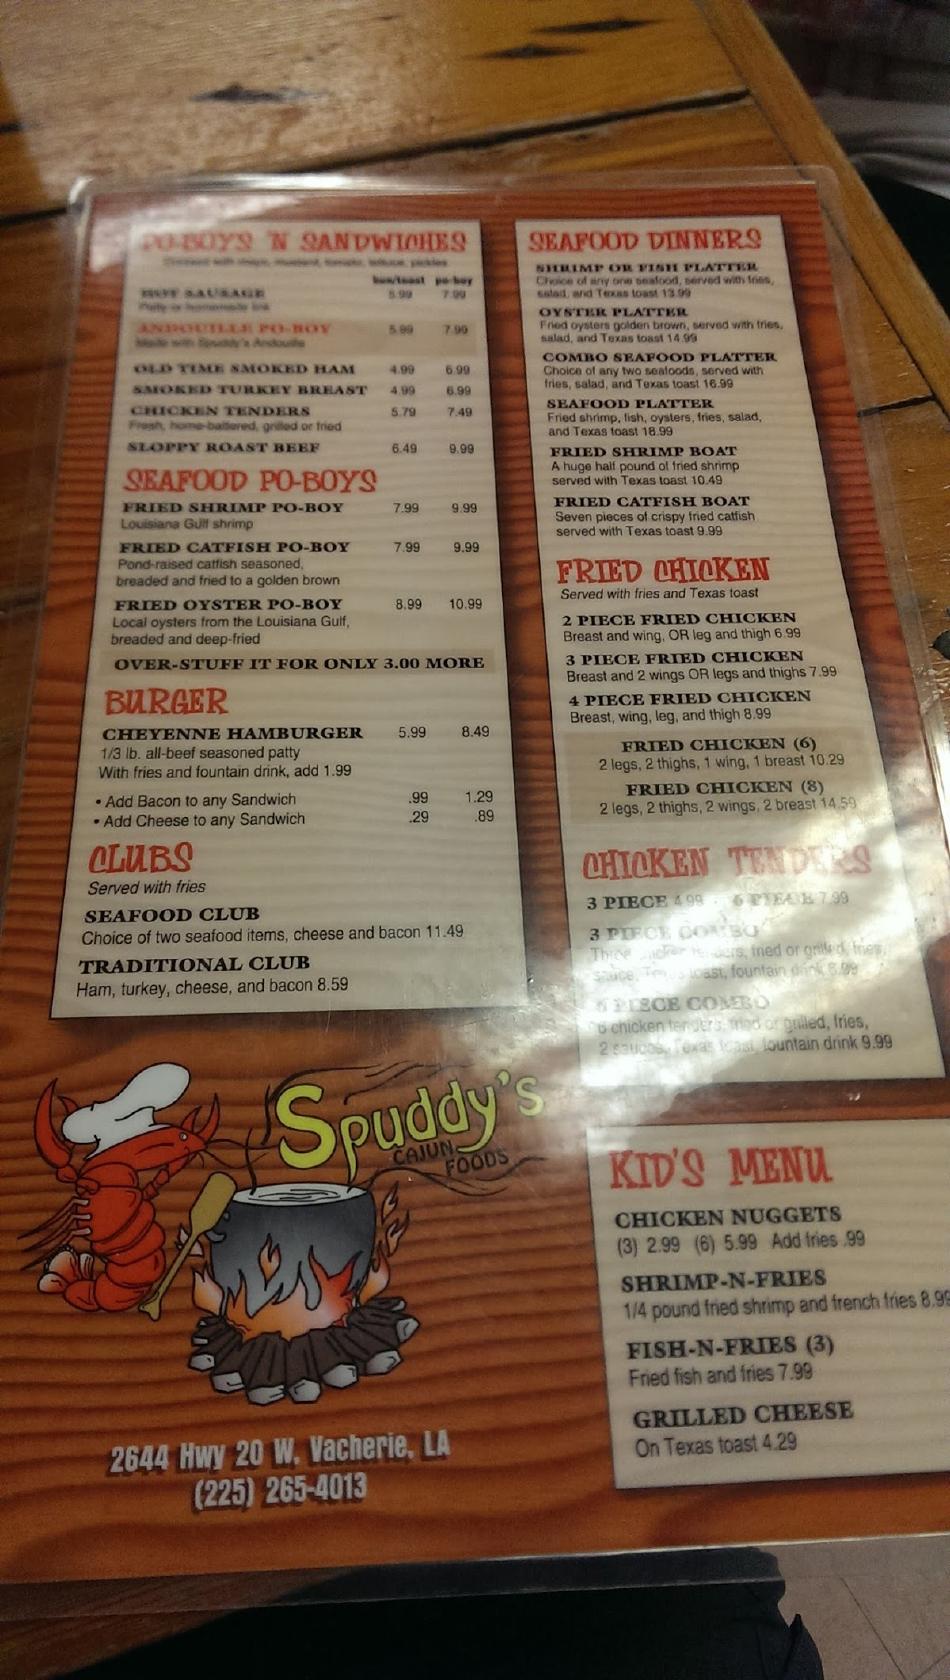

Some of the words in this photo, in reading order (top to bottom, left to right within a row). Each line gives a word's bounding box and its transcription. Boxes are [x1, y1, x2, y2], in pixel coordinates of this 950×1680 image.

[300, 231, 467, 251] SANDWICHES
[529, 230, 640, 252] SEAFOOD
[647, 229, 760, 251] DINNERS
[538, 306, 607, 317] OYSTER
[611, 306, 688, 317] PLATTER
[541, 351, 608, 363] COMBO
[612, 351, 695, 362] SEAFOOD
[699, 351, 777, 362] PLATTER
[132, 362, 173, 374] OLD
[176, 362, 224, 375] TIME
[229, 363, 308, 375] SMOKED
[313, 363, 355, 375] HAM
[388, 363, 415, 375] 4.99
[444, 364, 470, 376] 6.99
[132, 384, 212, 395] SMOKED
[216, 384, 291, 395] TURKEY
[296, 384, 368, 396] BREAST
[389, 384, 416, 396] 4.99
[445, 384, 471, 397] 6.99
[129, 404, 218, 416] CHICKEN
[223, 405, 310, 417] TENDERS
[390, 405, 417, 418] 5.79
[446, 406, 473, 418] 7.49
[546, 398, 630, 409] SEAFOOD
[634, 398, 714, 409] PLATTER
[547, 426, 570, 437] and
[571, 425, 608, 437] Texas
[609, 426, 639, 437] toast
[641, 425, 673, 437] 18.99
[126, 441, 200, 453] SLOPPY
[204, 441, 268, 453] ROAST
[272, 441, 320, 453] BEEF
[391, 442, 417, 454] 6.49
[448, 442, 474, 455] 9.99
[549, 446, 607, 457] FRIED
[611, 445, 684, 458] SHRIMP
[688, 445, 737, 457] BOAT
[125, 468, 248, 493] SEAFOOD
[256, 468, 379, 493] PO-BOYS
[122, 501, 183, 513] FRIED
[187, 502, 267, 513] SHRIMP
[271, 502, 344, 513] PO-BOY
[392, 501, 419, 514] 7.99
[450, 501, 478, 514] 9.99
[553, 496, 611, 508] FRIED
[616, 495, 697, 507] CATFISH
[700, 495, 750, 507] BOAT
[118, 541, 181, 554] FRIED
[185, 541, 271, 554] CATFISH
[275, 540, 350, 553] PO-BOY
[392, 540, 420, 553] 7.99
[452, 540, 480, 553] 9.99
[557, 559, 643, 584] FRIED
[653, 557, 770, 583] CHICKEN
[114, 599, 177, 611] FRIED
[182, 598, 262, 611] OYSTER
[266, 597, 343, 610] PO-BOY
[395, 597, 422, 610] 8.99
[448, 597, 482, 610] 10.99
[561, 614, 572, 626] 2
[576, 613, 635, 626] PIECE
[639, 612, 701, 626] FRIED
[704, 611, 796, 624] CHICKEN
[113, 658, 244, 671] OVER-STUFF
[248, 657, 272, 670] IT
[275, 657, 319, 670] FOR
[323, 657, 379, 670] ONLY
[383, 657, 420, 669] 3.00
[424, 656, 485, 669] MORE
[565, 654, 575, 666] 3
[579, 653, 640, 666] PIECE
[644, 651, 706, 665] FRIED
[710, 650, 803, 664] CHICKEN
[104, 686, 227, 716] BURGER
[568, 694, 580, 706] 4
[583, 692, 645, 706] PIECE
[647, 692, 712, 706] FRIED
[716, 689, 811, 703] CHICKEN
[681, 707, 706, 721] and
[708, 707, 740, 723] thigh
[742, 706, 772, 720] 8.99
[101, 727, 221, 741] CHEYENNE
[225, 726, 364, 740] HAMBURGER
[397, 725, 426, 739] 5.99
[461, 724, 489, 738] 8.49
[620, 739, 684, 753] FRIED
[689, 736, 785, 751] CHICKEN
[792, 735, 816, 752] (6)
[100, 746, 121, 760] 1/3
[145, 745, 196, 760] all-beef
[198, 745, 265, 759] seasoned
[267, 745, 301, 762] patty
[624, 782, 690, 797] FRIED
[695, 779, 793, 795] CHICKEN
[800, 779, 824, 796] (8)
[89, 842, 194, 873] CLUBS
[584, 849, 708, 879] CHICKEN
[83, 907, 192, 924] SEAFOOD
[198, 906, 260, 921] CLUB
[77, 956, 243, 974] TRADITIONAL
[247, 954, 310, 971] CLUB
[236, 977, 265, 993] and
[268, 977, 313, 993] bacon
[316, 975, 348, 992] 8.59
[276, 1070, 544, 1187] Spuddy's
[393, 1141, 453, 1165] CAJUN
[446, 1151, 509, 1176] FOODS
[610, 1148, 703, 1189] KID'S
[728, 1146, 831, 1186] MENU
[613, 1208, 723, 1229] CHICKEN
[729, 1205, 842, 1225] NUGGETS
[616, 1236, 638, 1258] (3)
[645, 1235, 680, 1254] 2.99
[693, 1233, 715, 1255] (6)
[723, 1232, 758, 1252] 5.99
[770, 1231, 802, 1249] Add
[804, 1230, 838, 1248] fries
[620, 1268, 827, 1293] SHRIMP-N-FRIES
[625, 1335, 797, 1360] FISH-N-FRIES
[805, 1334, 834, 1357] (3)
[627, 1366, 670, 1387] Fried
[672, 1366, 703, 1386] fish
[705, 1364, 737, 1384] and
[739, 1363, 775, 1382] fries
[776, 1361, 813, 1381] 7.99
[632, 1405, 747, 1429] GRILLED
[753, 1400, 854, 1424] CHEESE
[111, 1444, 168, 1471] 2644
[180, 1442, 225, 1469] Hwy
[236, 1439, 262, 1465] 20
[424, 1429, 450, 1455] LA
[634, 1437, 660, 1458] On
[662, 1435, 714, 1456] Texas
[716, 1433, 759, 1454] toast
[761, 1430, 797, 1451] 4.29
[195, 1477, 253, 1509] (225)
[266, 1472, 366, 1502] 265-4013
